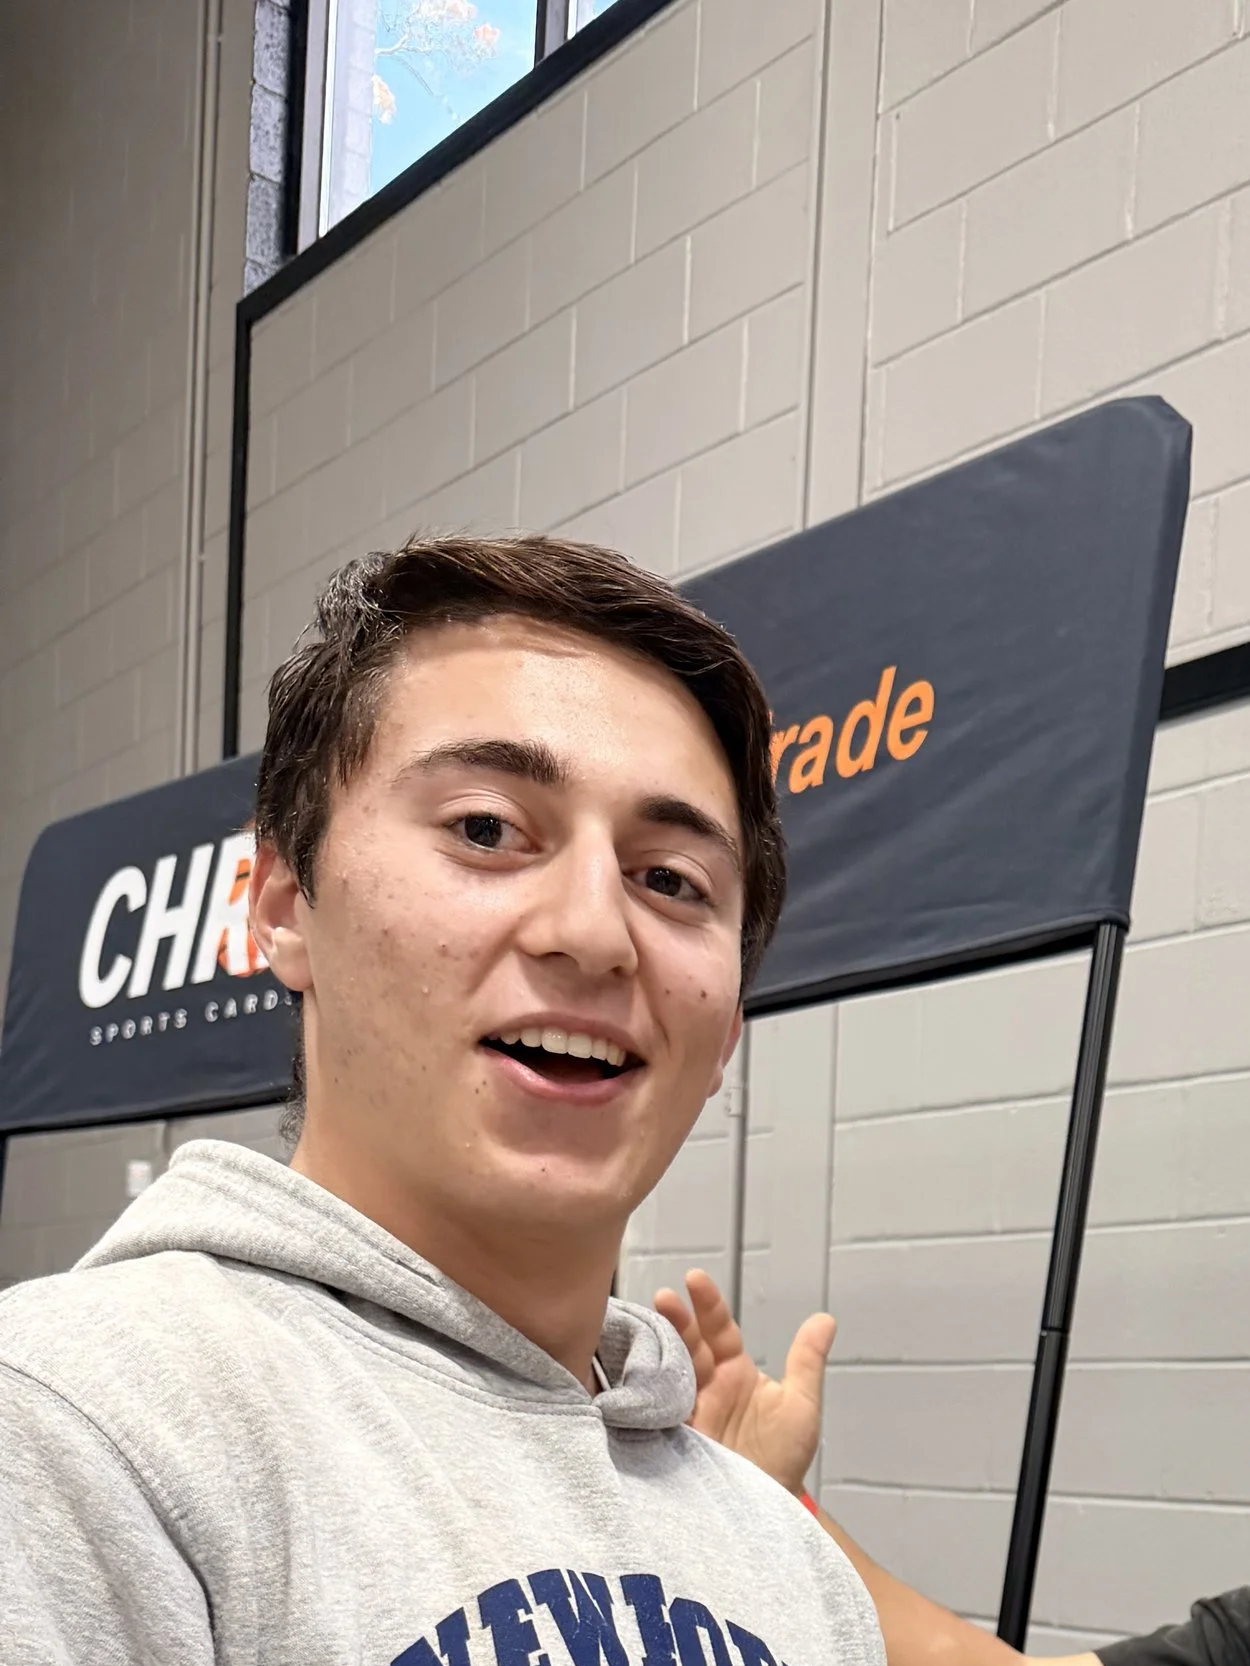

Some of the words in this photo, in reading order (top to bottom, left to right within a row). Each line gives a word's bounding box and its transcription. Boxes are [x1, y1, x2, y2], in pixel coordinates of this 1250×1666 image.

[768, 665, 935, 794] rade
[78, 831, 269, 1009] CHR
[89, 1008, 188, 1046] SPORTS
